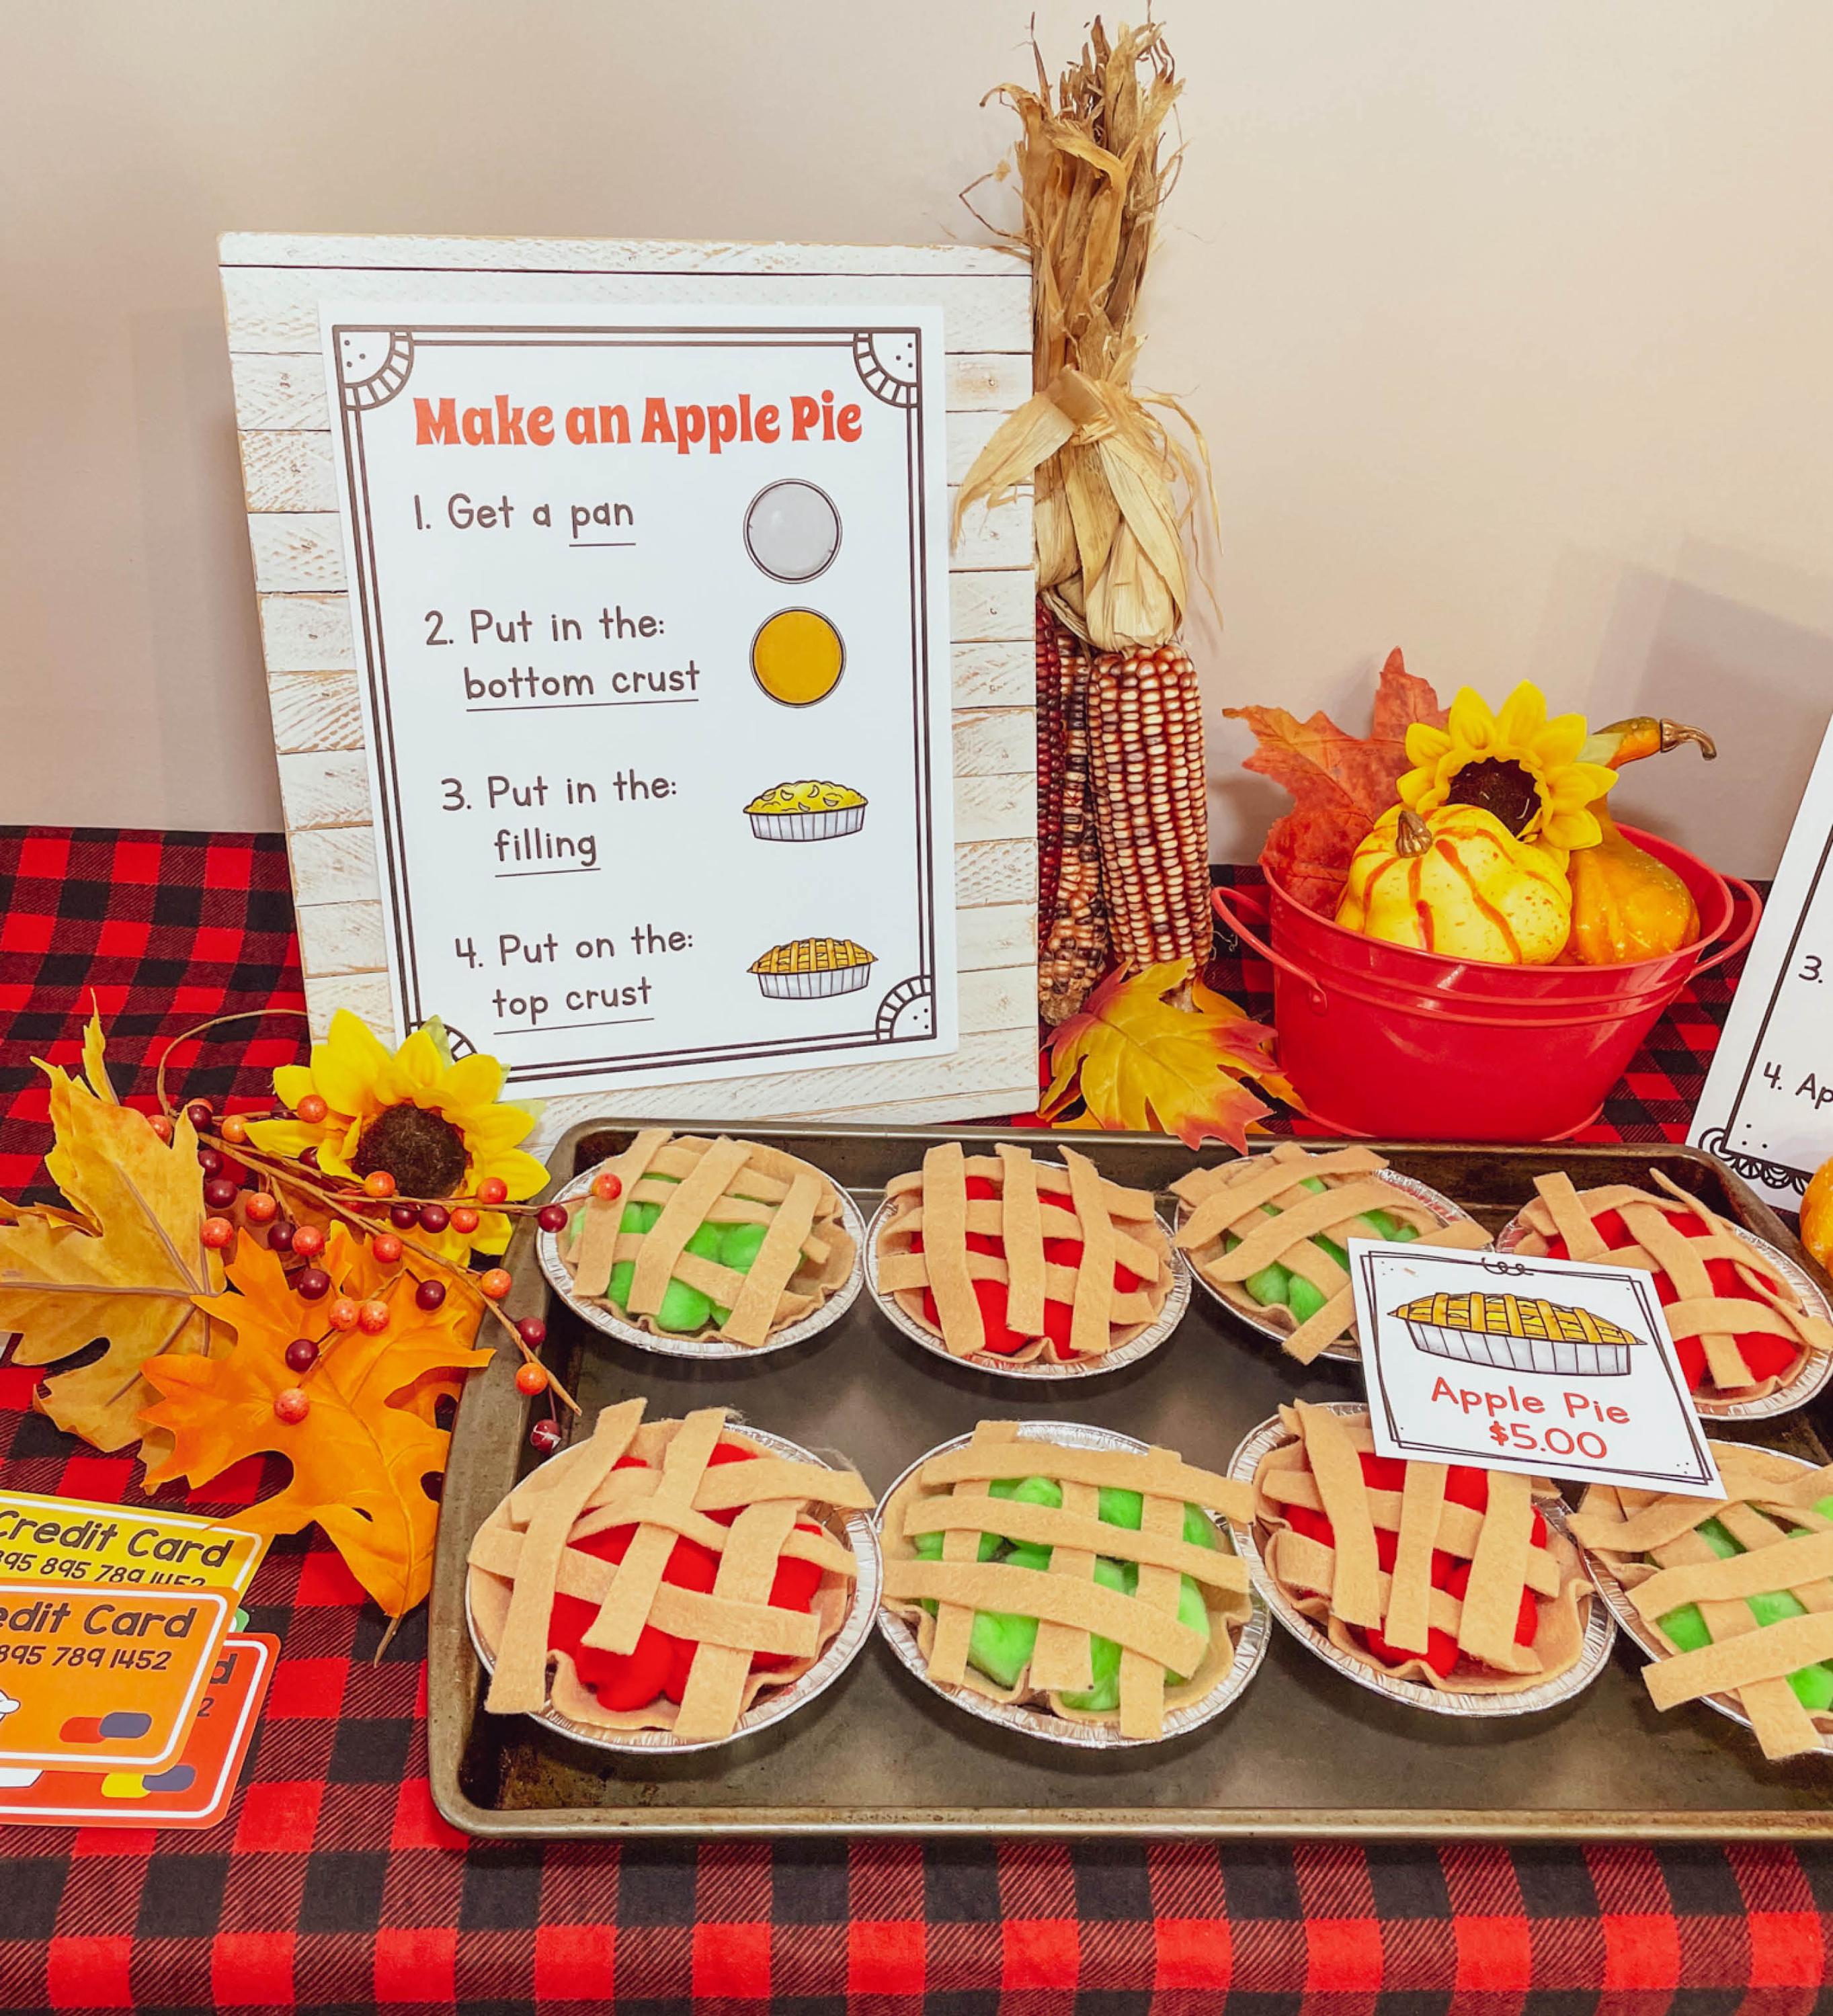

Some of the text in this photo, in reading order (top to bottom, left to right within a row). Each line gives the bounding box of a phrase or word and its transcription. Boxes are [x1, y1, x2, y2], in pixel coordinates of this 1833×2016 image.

[414, 390, 862, 454] Make an Apple Pie
[414, 493, 633, 540] 1. Get a pan
[424, 605, 664, 646] 2. Put in the:
[464, 660, 700, 700] bottom crust
[441, 769, 677, 811] 3. Put in the:
[494, 827, 596, 867] filling
[455, 923, 693, 969] 4. Put on the:
[1798, 955, 1823, 984] 3.
[492, 976, 652, 1025] top crust
[1763, 1061, 1783, 1091] 4.
[1432, 1376, 1630, 1424] Apple Pie
[1489, 1420, 1607, 1459] $5.00
[0, 1550, 38, 1572] 95
[40, 1557, 91, 1579] 895
[93, 1564, 145, 1583] 789
[127, 1528, 235, 1568] Card
[84, 1604, 198, 1638] Card
[51, 1646, 106, 1668] 789
[109, 1648, 172, 1670] 1452
